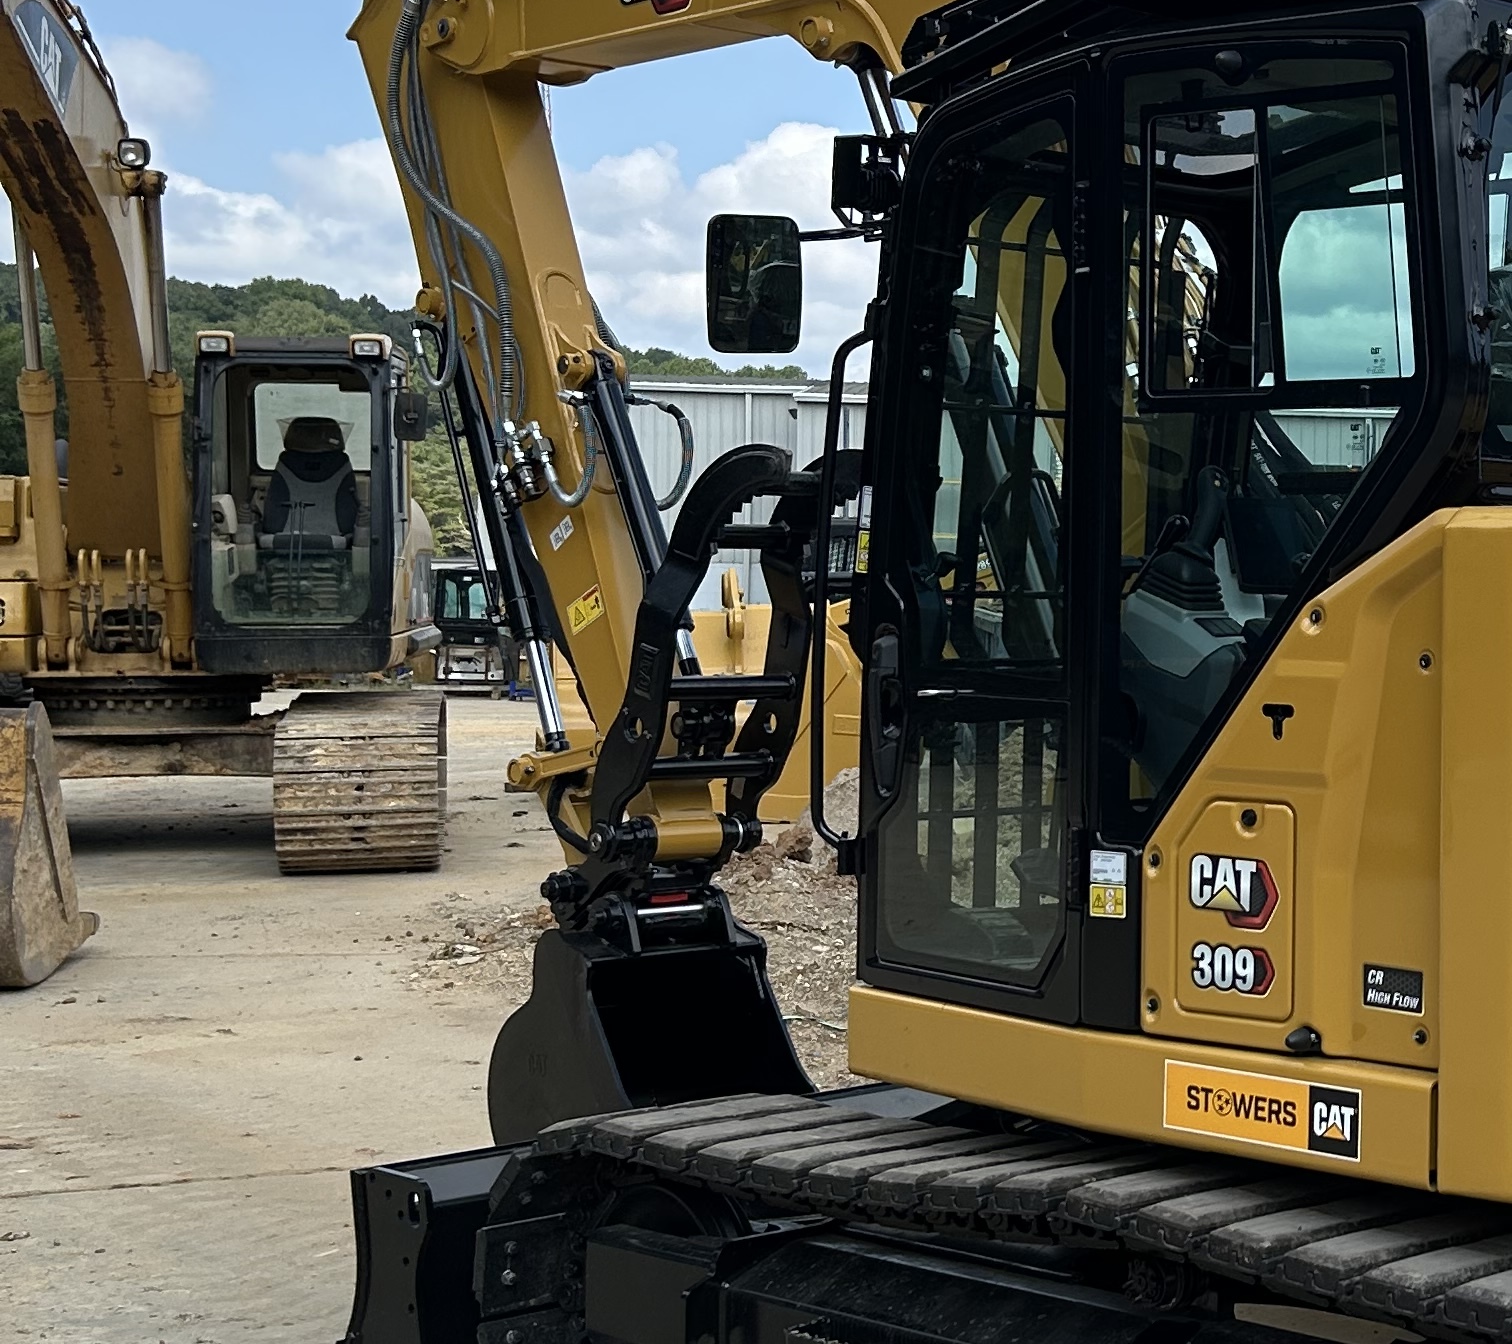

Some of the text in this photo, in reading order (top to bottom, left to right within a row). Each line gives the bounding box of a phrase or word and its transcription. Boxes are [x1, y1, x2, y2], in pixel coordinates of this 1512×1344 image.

[40, 15, 62, 100] CAT
[1190, 854, 1257, 913] CAT
[1193, 943, 1255, 992] 309
[1367, 969, 1384, 986] CR
[1366, 988, 1420, 1009] HIGH FLOW
[1186, 1084, 1356, 1142] STOWERS CAT
